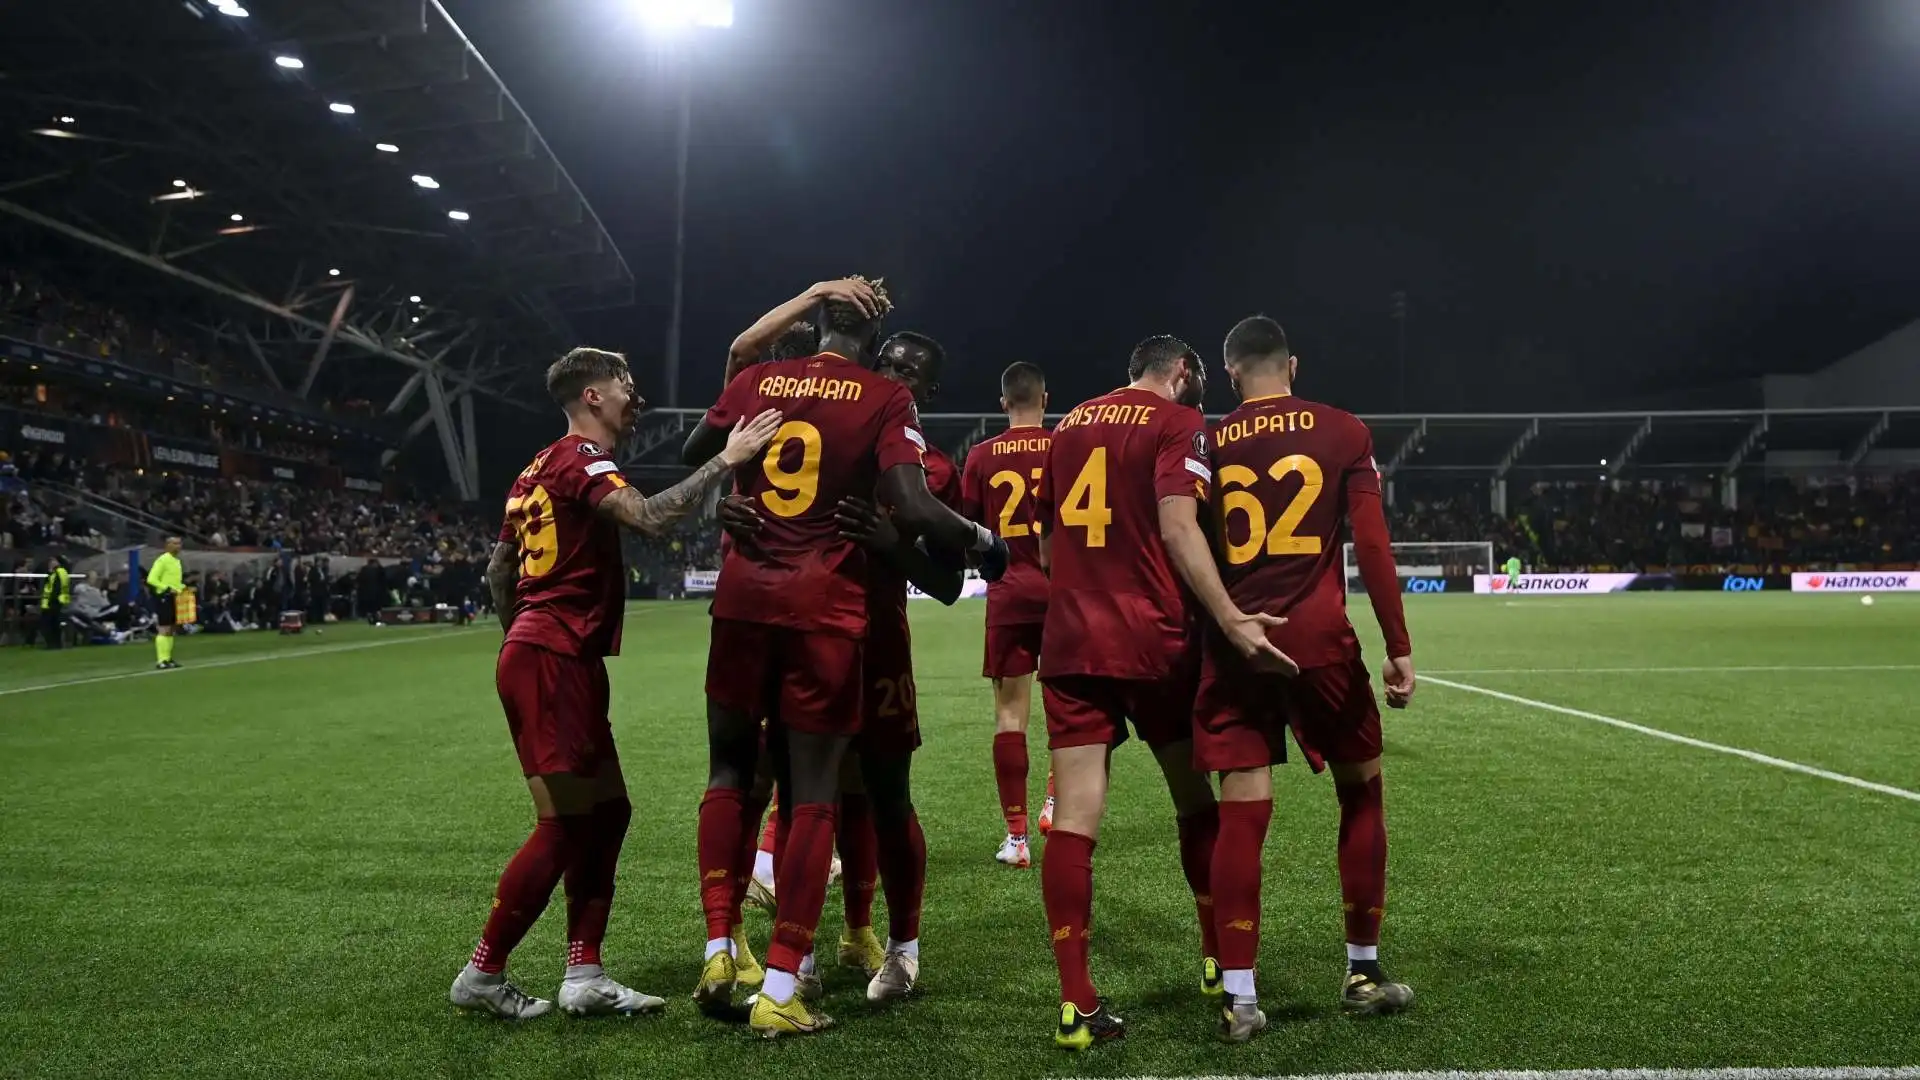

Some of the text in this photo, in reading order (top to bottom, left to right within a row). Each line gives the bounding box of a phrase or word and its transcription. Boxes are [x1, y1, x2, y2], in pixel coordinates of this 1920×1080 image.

[759, 375, 862, 401] ABRAHAM
[1059, 404, 1156, 433] CRISTANTE
[1216, 411, 1314, 448] VOLPATO
[993, 438, 1051, 456] MANCIN
[761, 420, 822, 517] 9
[1060, 446, 1112, 547] 4
[1217, 454, 1324, 565] 62
[874, 673, 914, 718] 20
